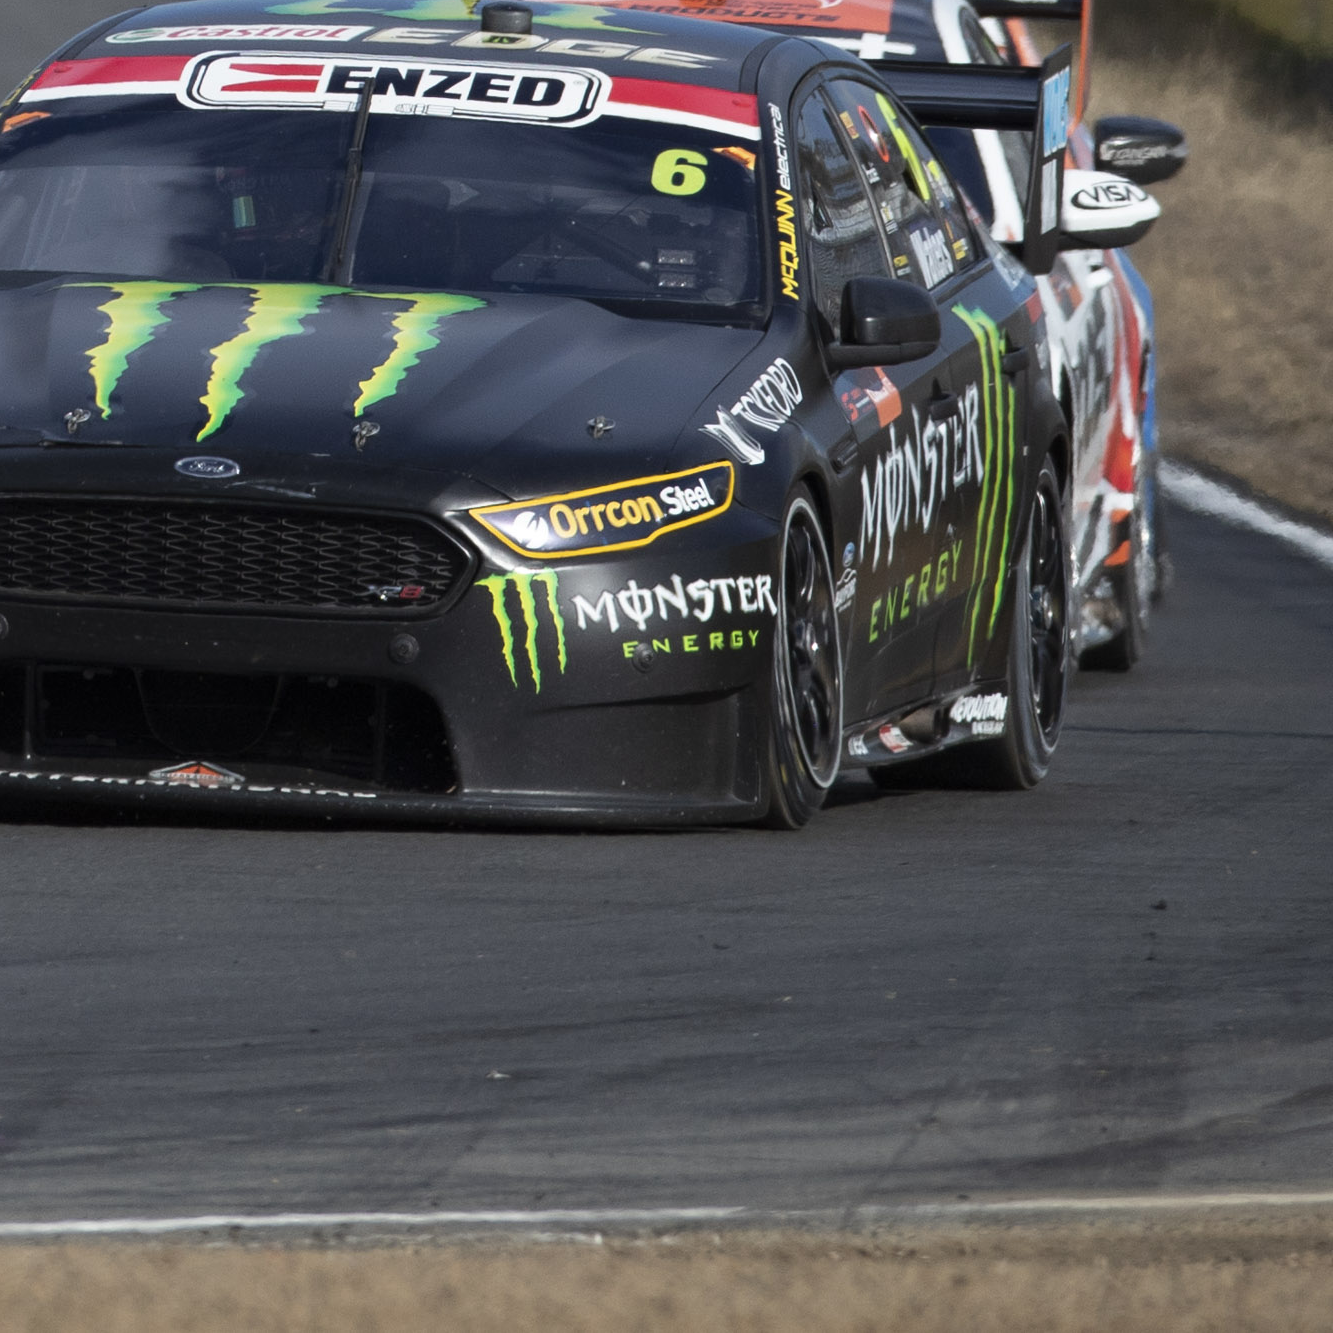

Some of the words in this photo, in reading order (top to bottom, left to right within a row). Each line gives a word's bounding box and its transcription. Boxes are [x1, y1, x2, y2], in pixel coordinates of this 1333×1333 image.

[166, 25, 342, 41] Castrol
[326, 65, 566, 107] ENZED
[650, 148, 709, 197] 6
[768, 102, 792, 191] electrical
[1083, 184, 1143, 204] VISA
[730, 356, 804, 433] TICKFORD
[549, 493, 664, 540] Orrcon
[658, 477, 715, 517] Steel
[570, 573, 778, 633] MONSTER
[867, 539, 963, 644] ENERGY
[622, 629, 760, 659] ENERGY
